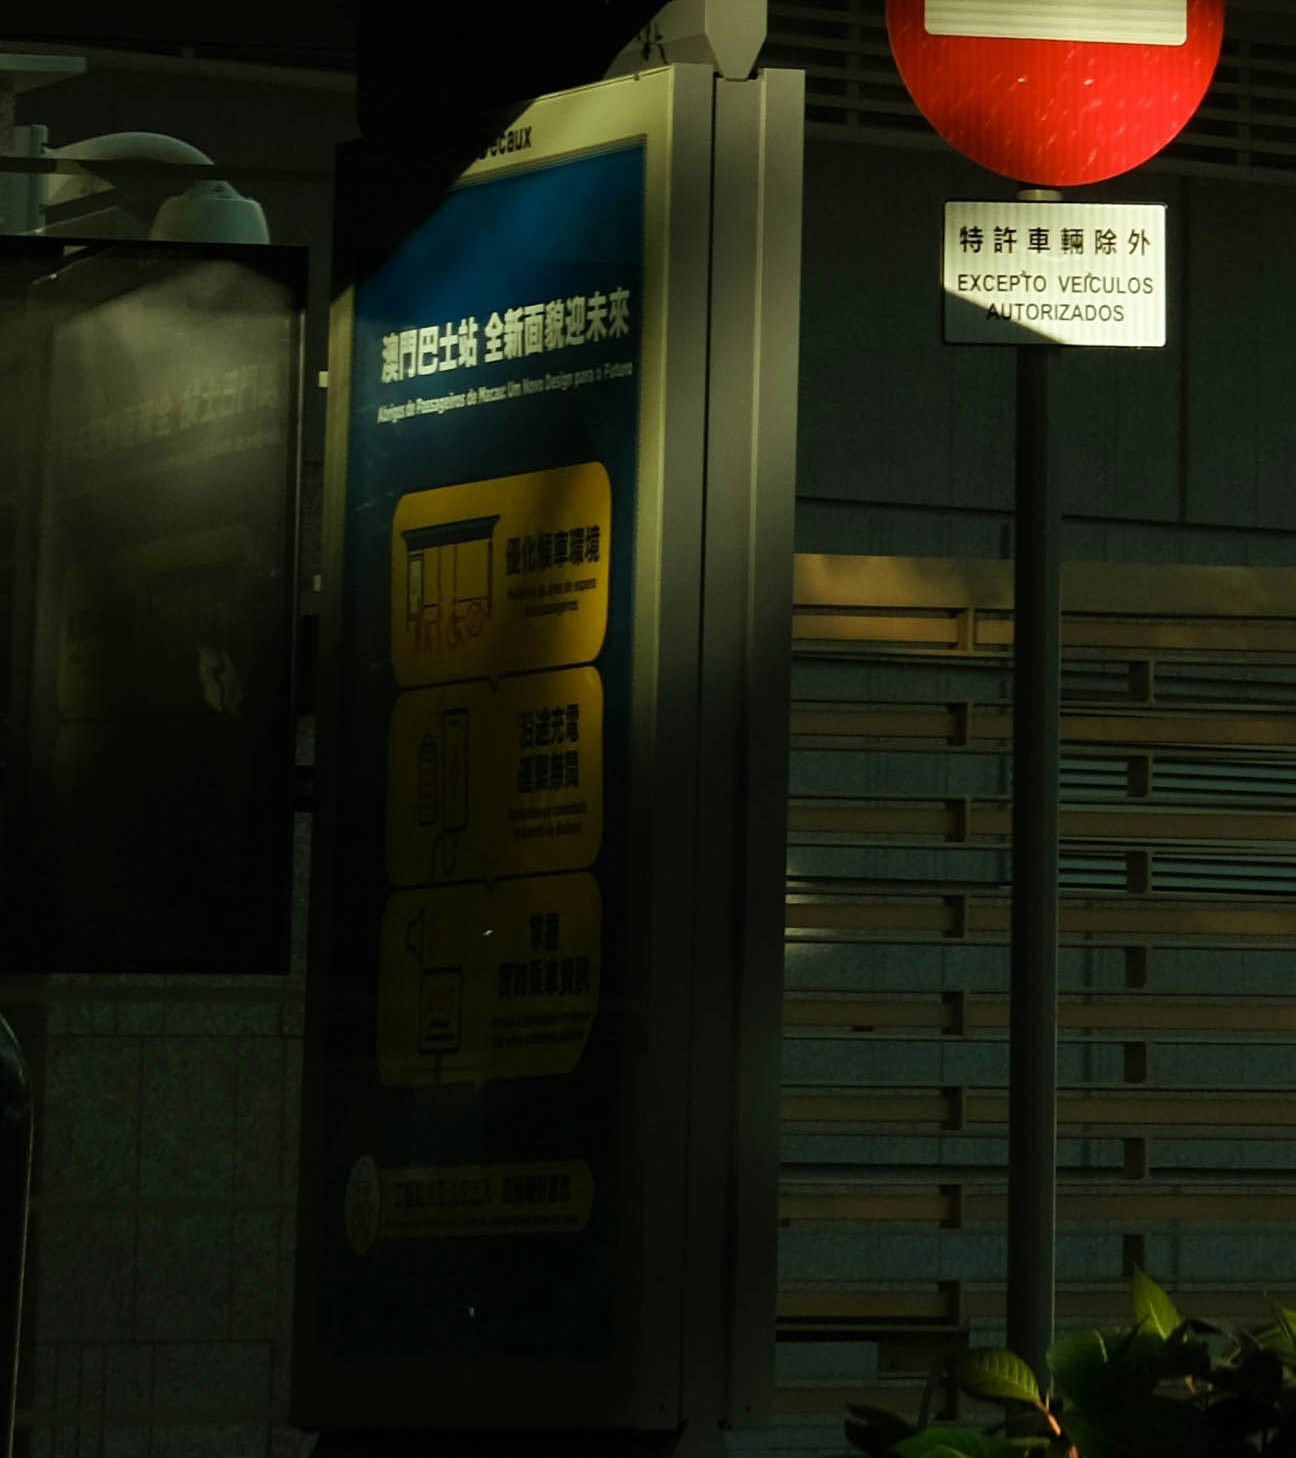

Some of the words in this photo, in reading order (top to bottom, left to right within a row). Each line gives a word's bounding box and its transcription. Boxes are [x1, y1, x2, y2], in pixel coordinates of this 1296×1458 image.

[960, 225, 1151, 256] 特許車輛除外
[958, 273, 1047, 292] EXCEPTO
[986, 303, 1125, 322] AUTORIZADOS
